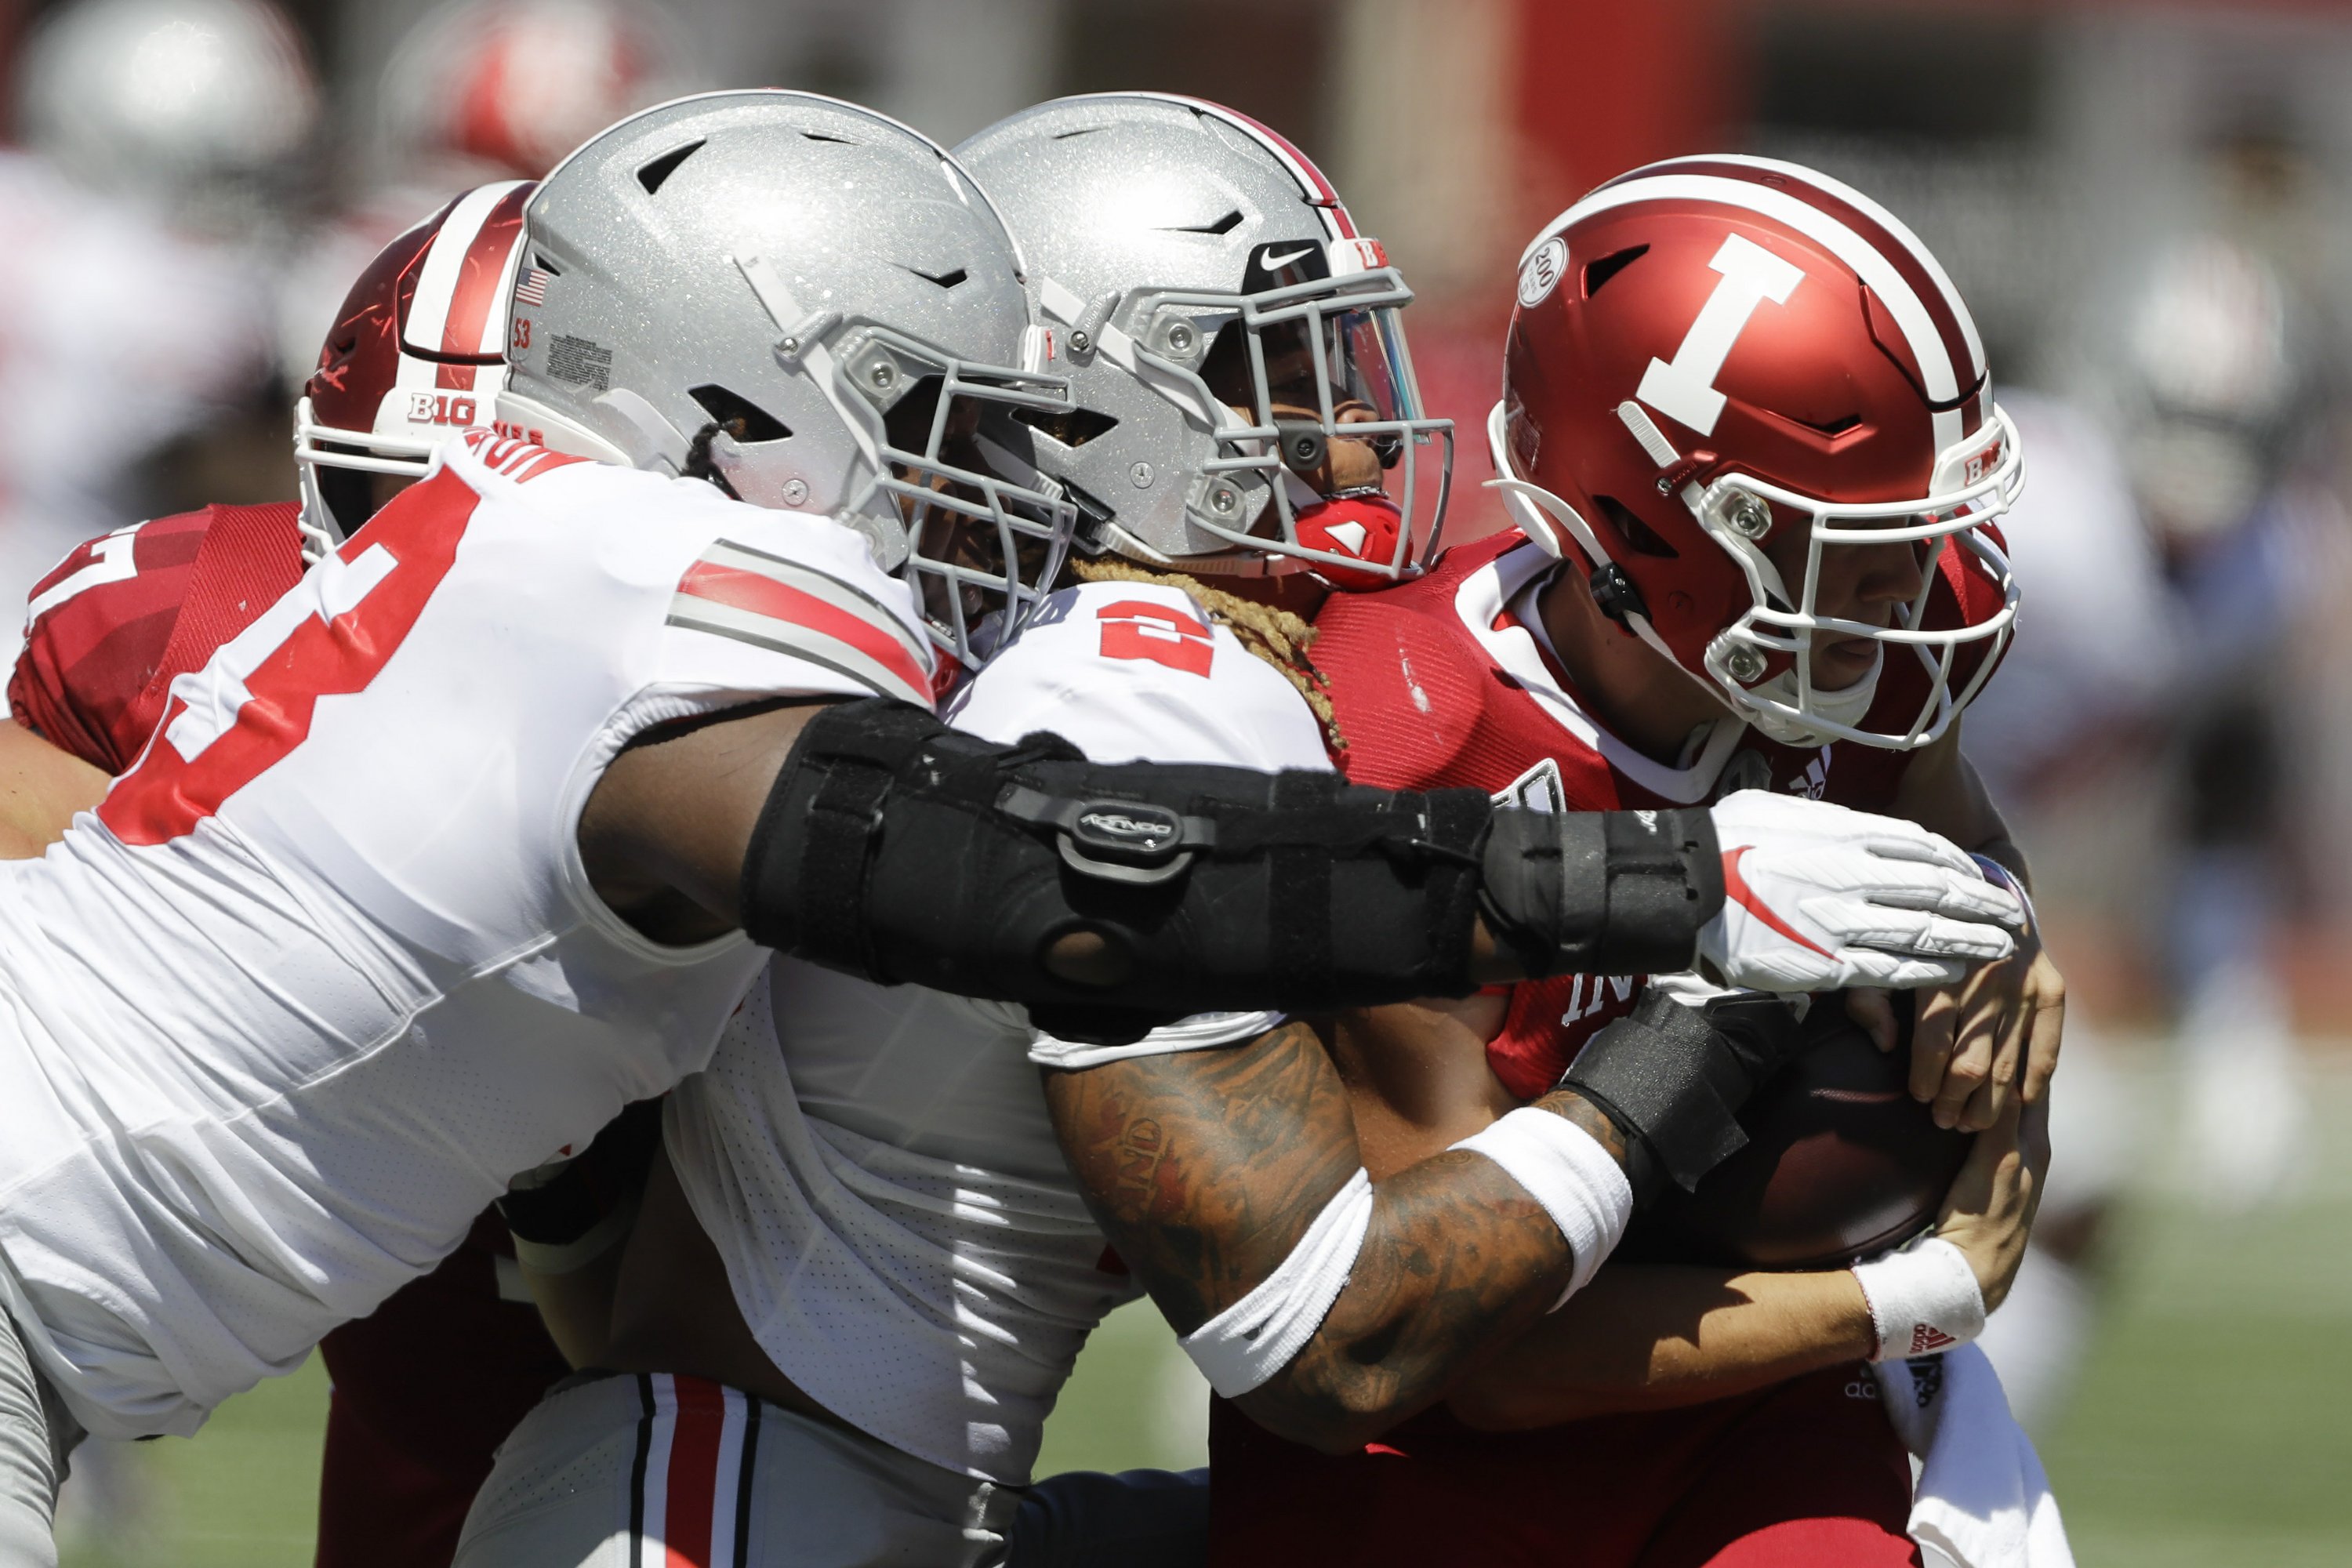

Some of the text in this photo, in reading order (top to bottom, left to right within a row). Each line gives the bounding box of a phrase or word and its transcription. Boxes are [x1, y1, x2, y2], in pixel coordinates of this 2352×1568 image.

[1535, 246, 1555, 287] 200
[514, 318, 531, 349] 53
[1635, 232, 1805, 437] I
[1096, 600, 1214, 680] 2
